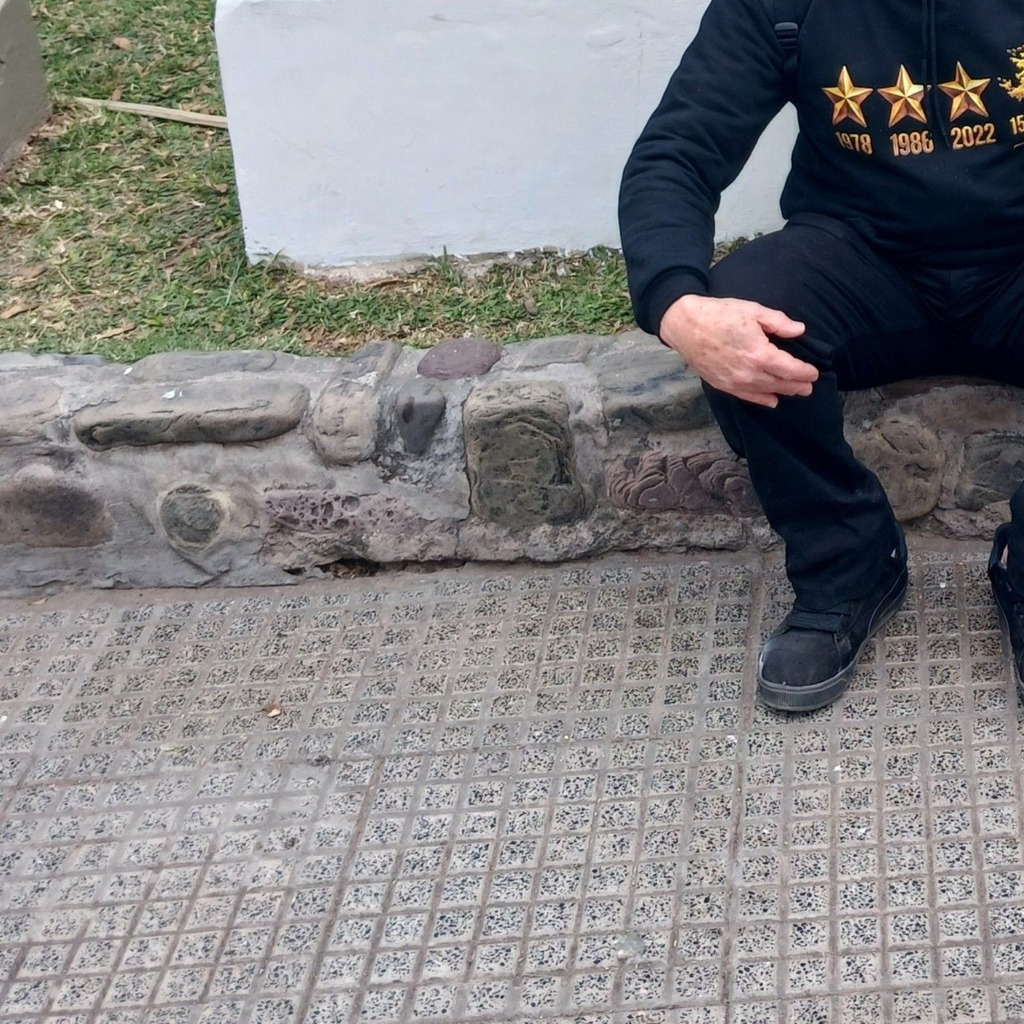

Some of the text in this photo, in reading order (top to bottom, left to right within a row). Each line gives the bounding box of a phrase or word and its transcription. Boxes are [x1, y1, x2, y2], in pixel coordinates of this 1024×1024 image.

[835, 122, 997, 157] 1978 1986 2022
